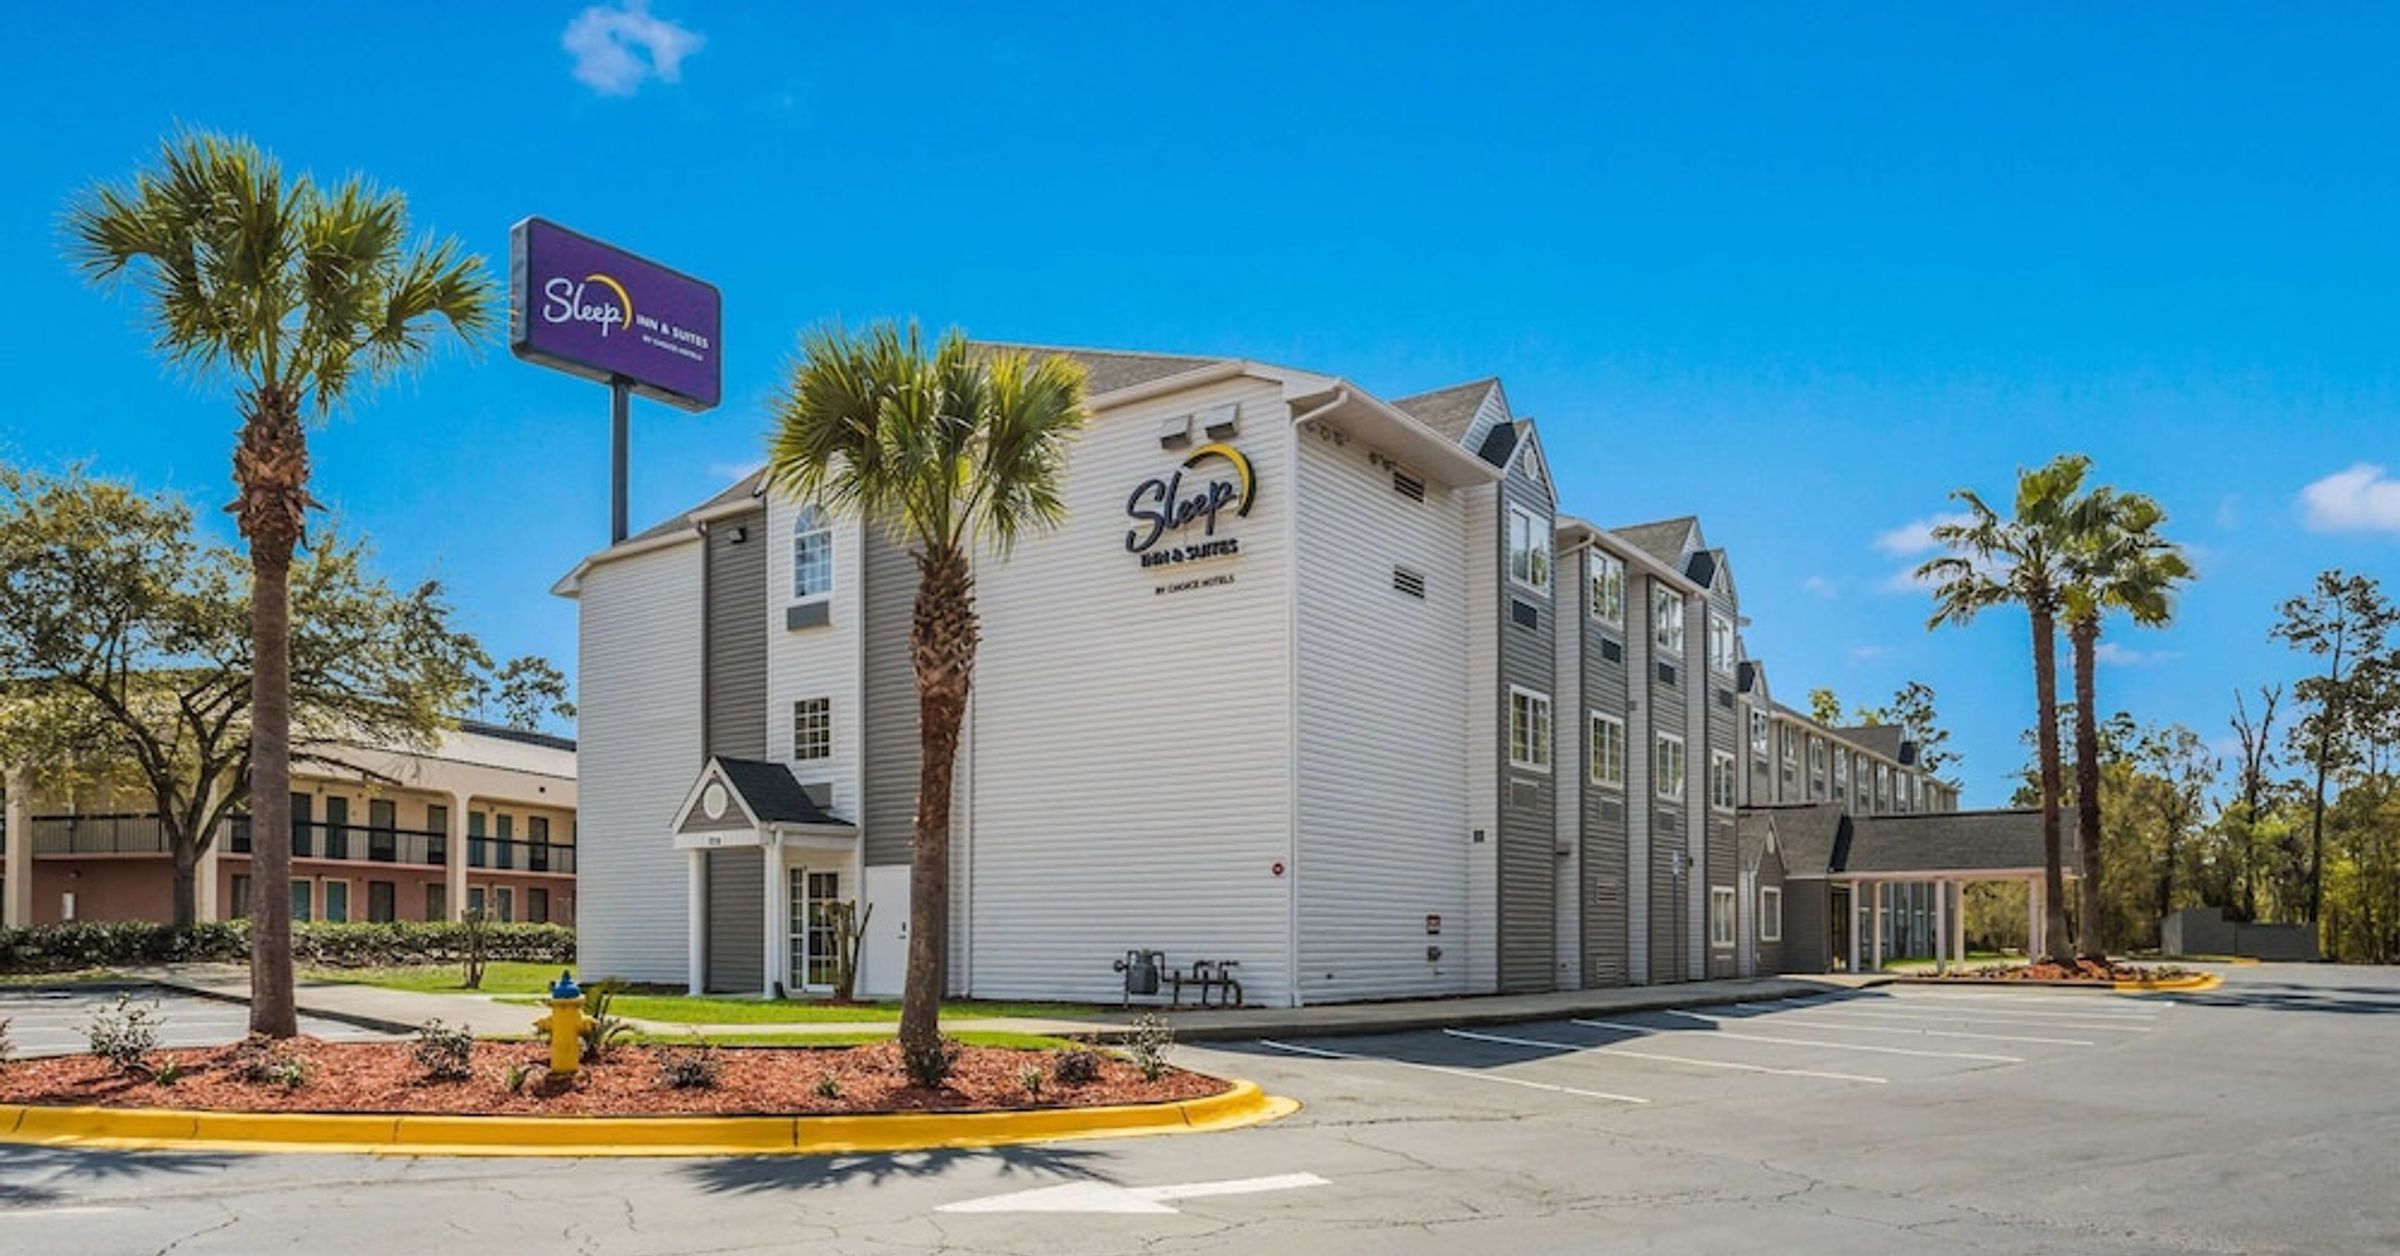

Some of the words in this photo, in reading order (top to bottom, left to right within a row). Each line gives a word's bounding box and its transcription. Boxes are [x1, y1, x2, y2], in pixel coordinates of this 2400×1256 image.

[543, 277, 623, 337] Sleep
[636, 314, 659, 331] INN
[660, 323, 670, 335] &
[672, 326, 709, 349] SUITES
[1126, 470, 1237, 553] Sleep
[1141, 550, 1170, 567] INN
[1171, 548, 1184, 562] &
[1186, 538, 1238, 560] SUITES
[1155, 586, 1165, 595] BY
[1168, 579, 1199, 593] CHOICE
[1202, 574, 1235, 587] HOTELS
